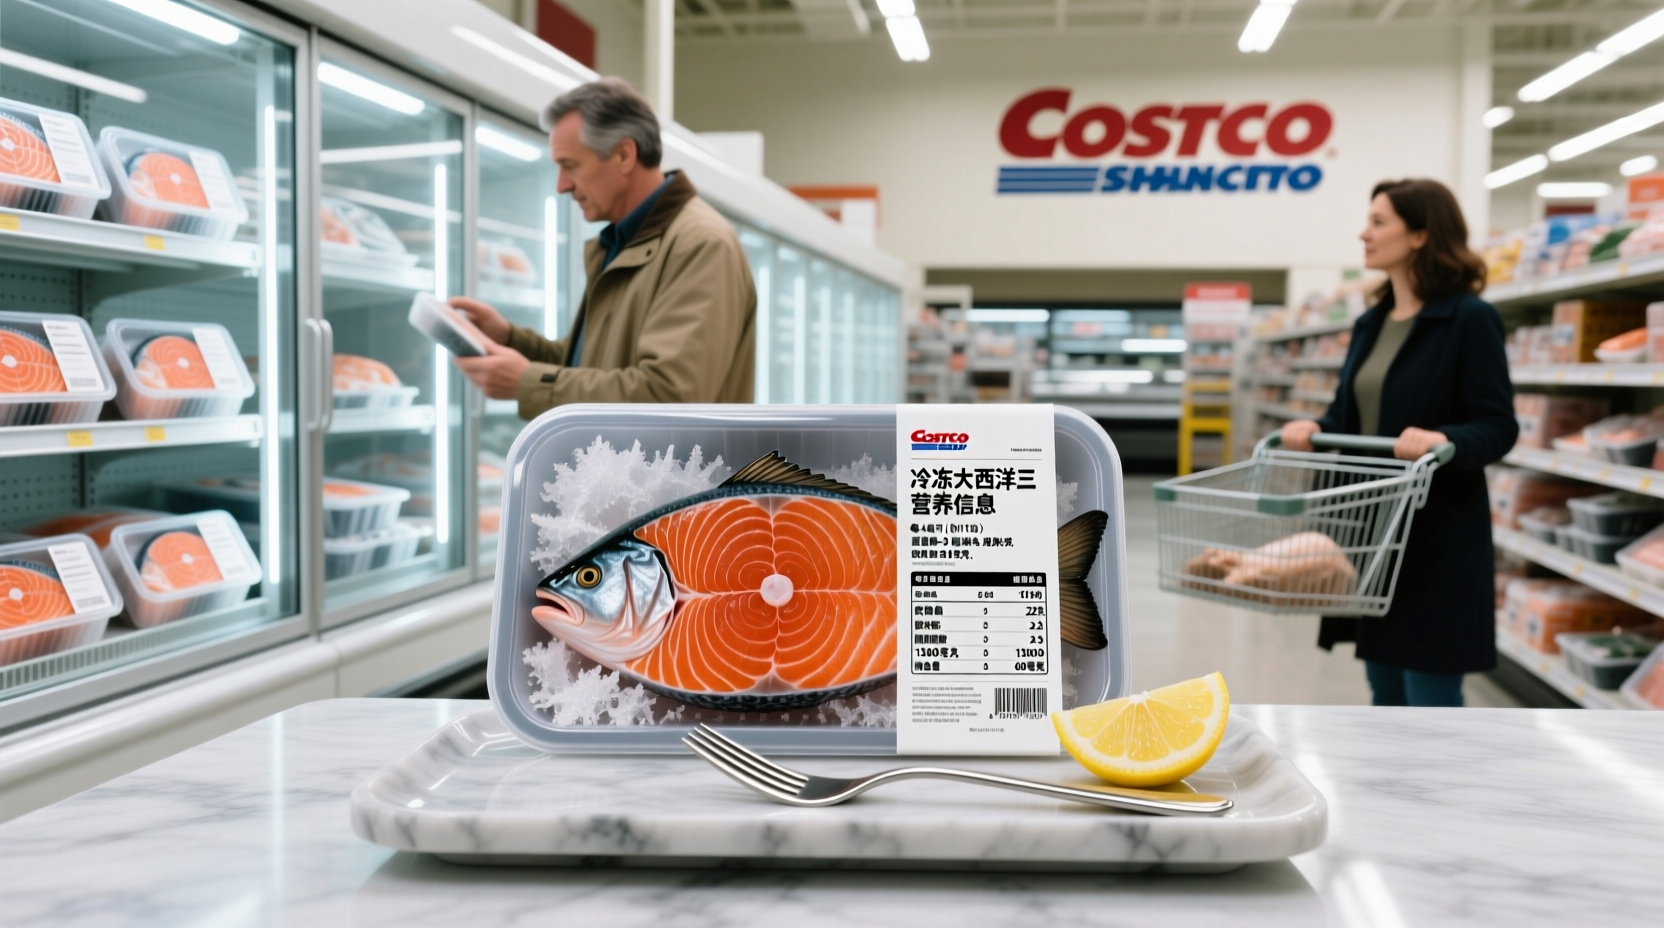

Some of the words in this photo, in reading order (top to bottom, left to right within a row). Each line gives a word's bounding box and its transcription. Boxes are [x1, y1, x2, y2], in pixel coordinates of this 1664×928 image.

[999, 87, 1333, 158] COSTCO
[911, 467, 1036, 491] 冷冻大西洋三
[911, 491, 996, 515] 营养信息
